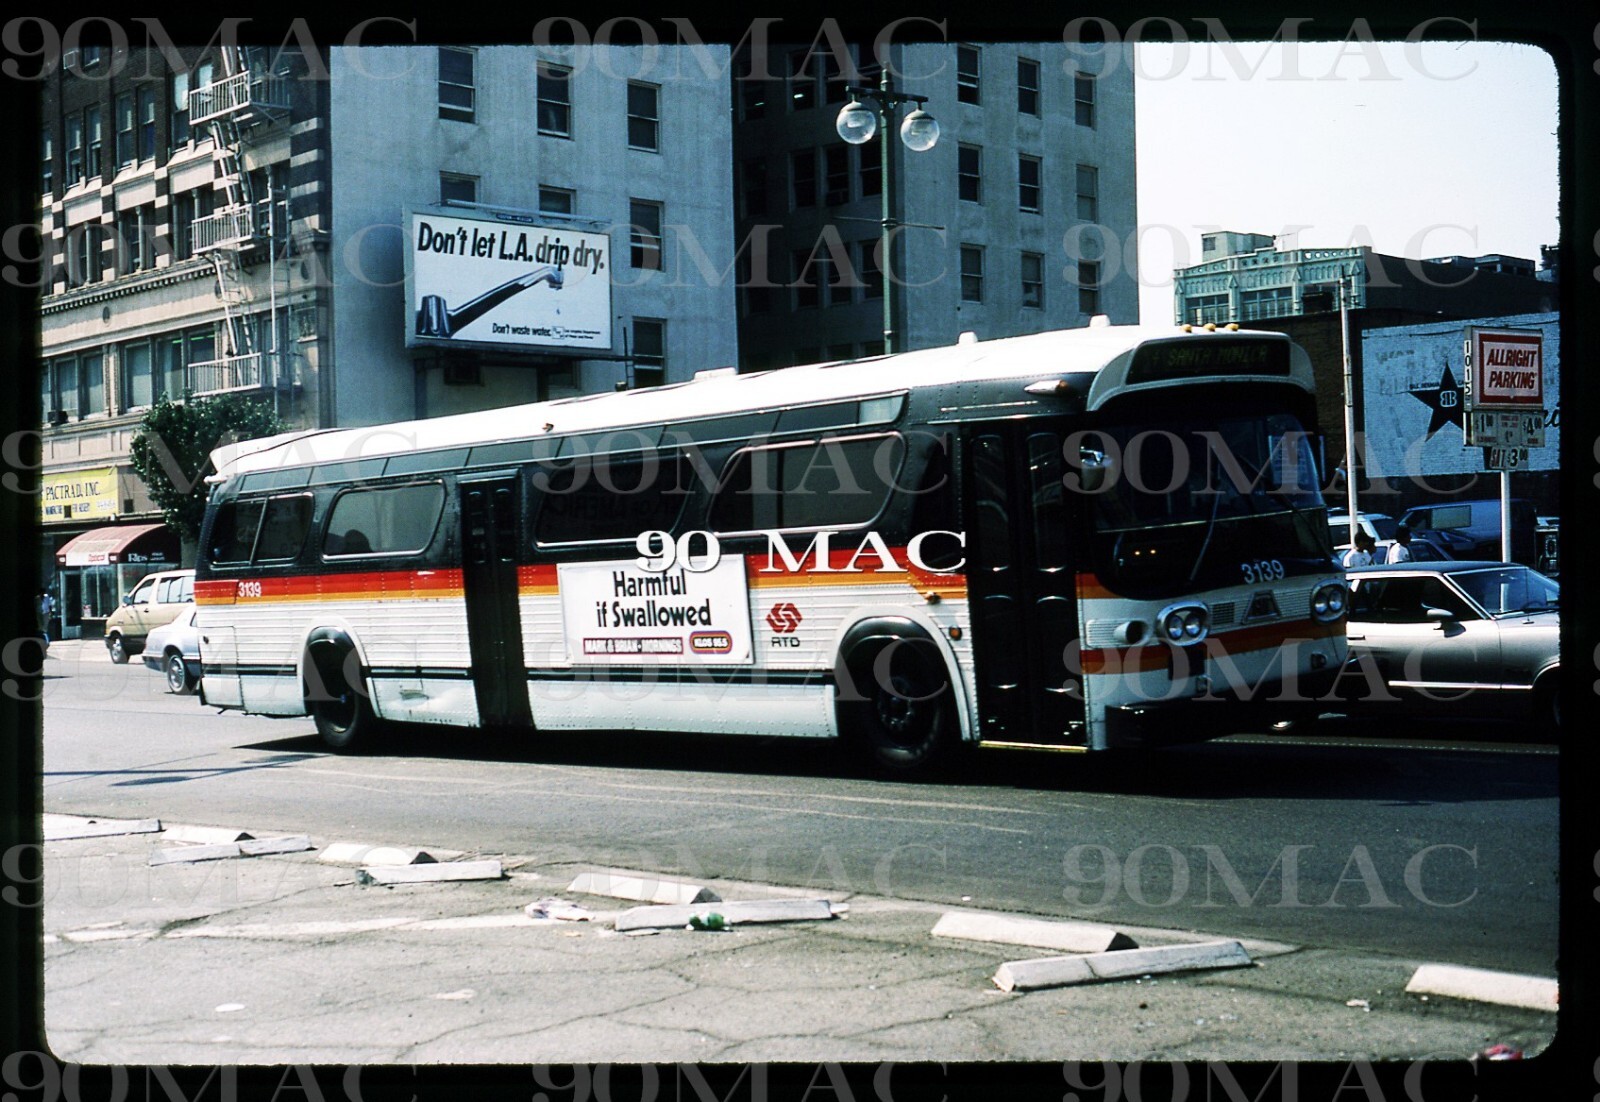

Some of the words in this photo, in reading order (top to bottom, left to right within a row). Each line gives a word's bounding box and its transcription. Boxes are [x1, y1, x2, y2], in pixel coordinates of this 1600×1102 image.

[418, 222, 467, 256] Don't
[471, 228, 496, 258] let
[499, 230, 533, 262] L.A.
[536, 235, 570, 271] drip
[573, 239, 605, 274] dry.
[492, 322, 510, 334] Don't
[511, 325, 531, 335] waste
[1486, 349, 1537, 367] ALLRIGHT
[1488, 371, 1535, 389] PARKING
[1240, 559, 1285, 584] 3139
[238, 582, 262, 597] 3139
[612, 568, 687, 598] Harmful
[596, 601, 608, 628] if
[612, 598, 712, 628] Swallowed
[585, 638, 606, 653] MARK
[615, 638, 638, 653] BRIAN
[642, 638, 682, 653] MORNINGS
[694, 638, 712, 647] KLOS
[771, 637, 800, 648] RTD
